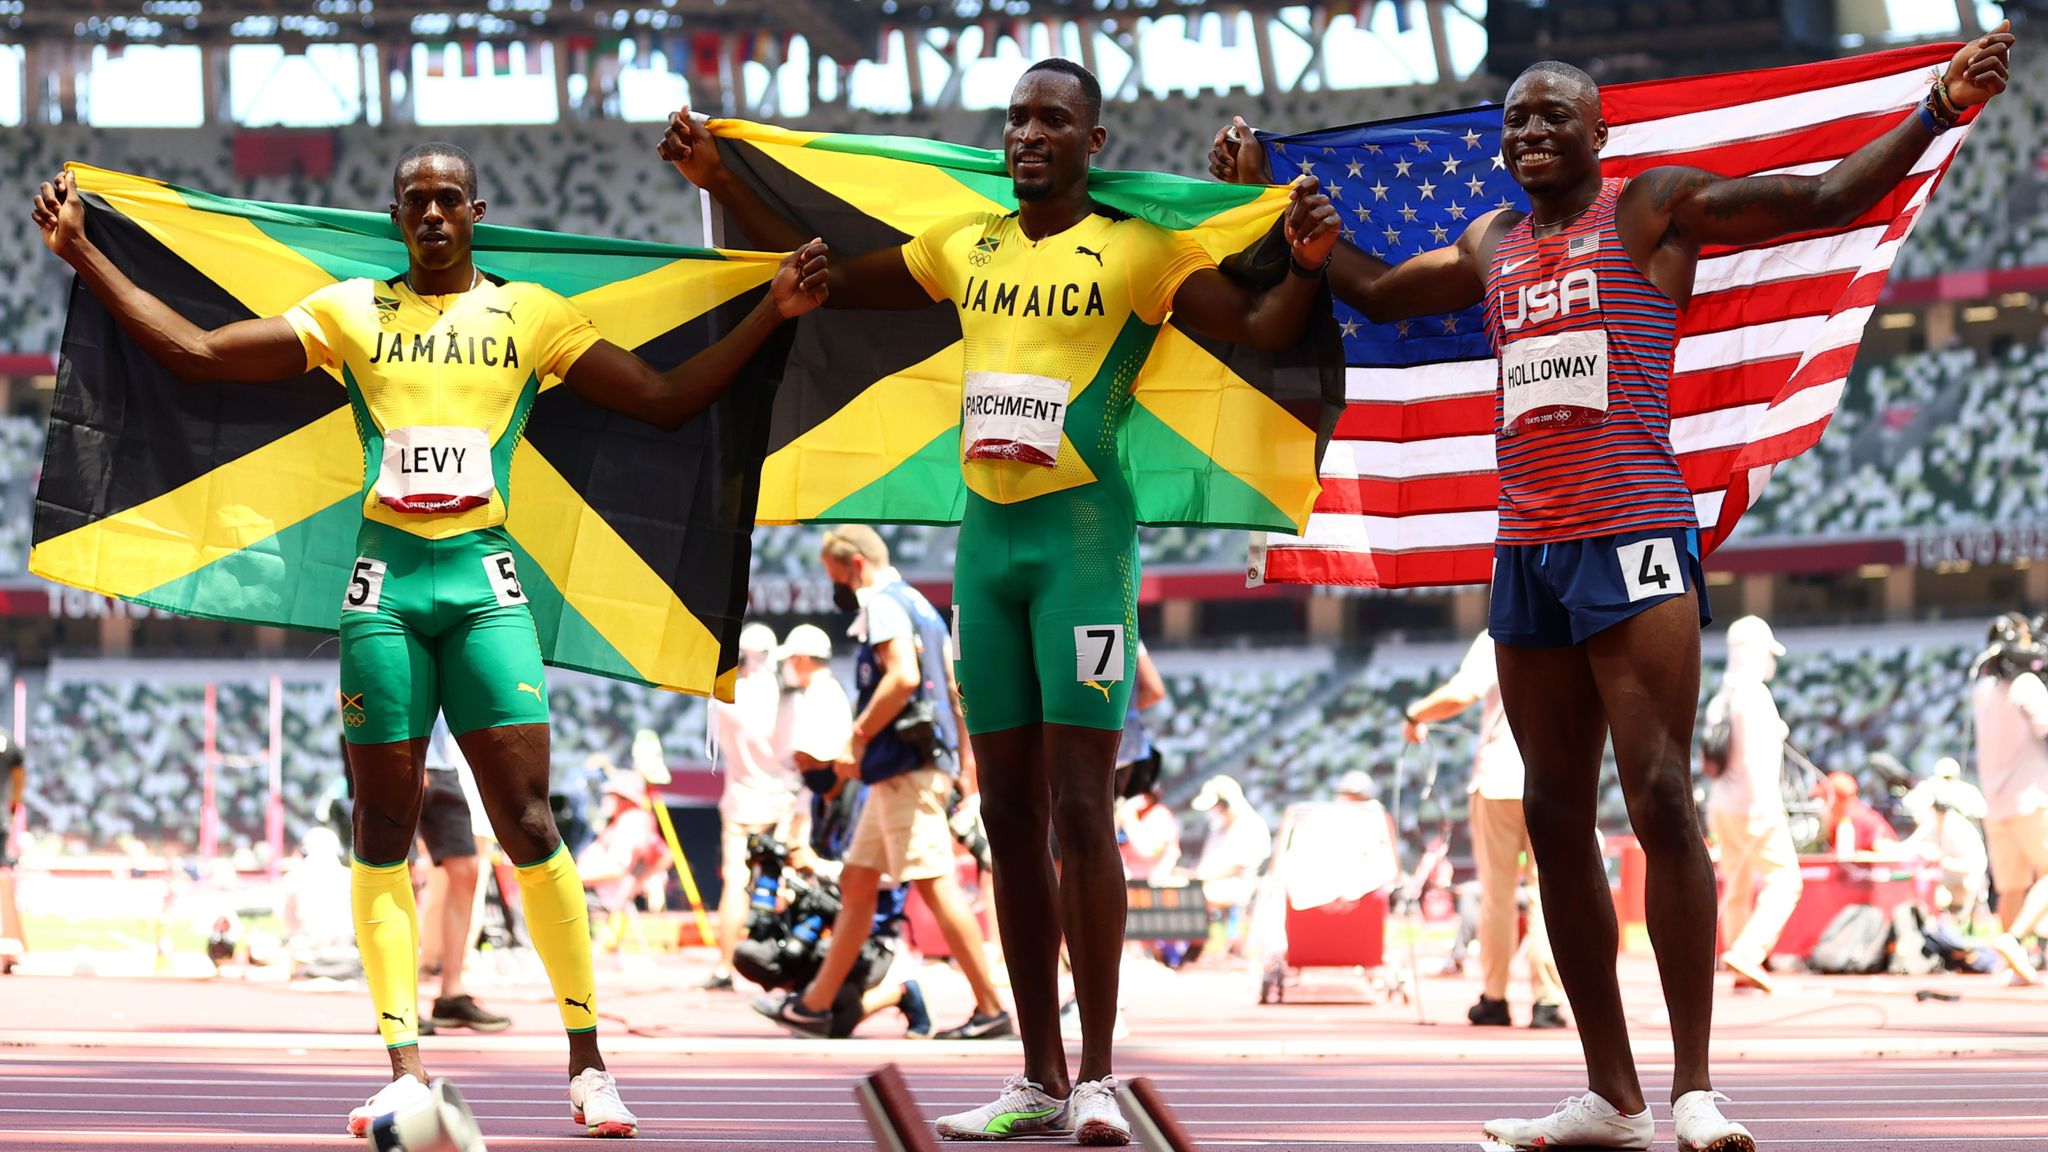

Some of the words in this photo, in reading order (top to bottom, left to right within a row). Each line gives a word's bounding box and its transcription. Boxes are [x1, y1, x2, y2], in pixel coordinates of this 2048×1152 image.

[962, 276, 1105, 317] JAMAICA
[1500, 268, 1600, 331] USA
[369, 332, 519, 368] JAMAICA
[1508, 355, 1598, 389] HOLLOWAY
[966, 395, 1062, 422] PARCHMENT
[401, 447, 466, 474] LEVY
[348, 561, 372, 605] 5
[496, 557, 520, 598] 5
[1639, 544, 1671, 589] 4
[1087, 630, 1116, 675] 7
